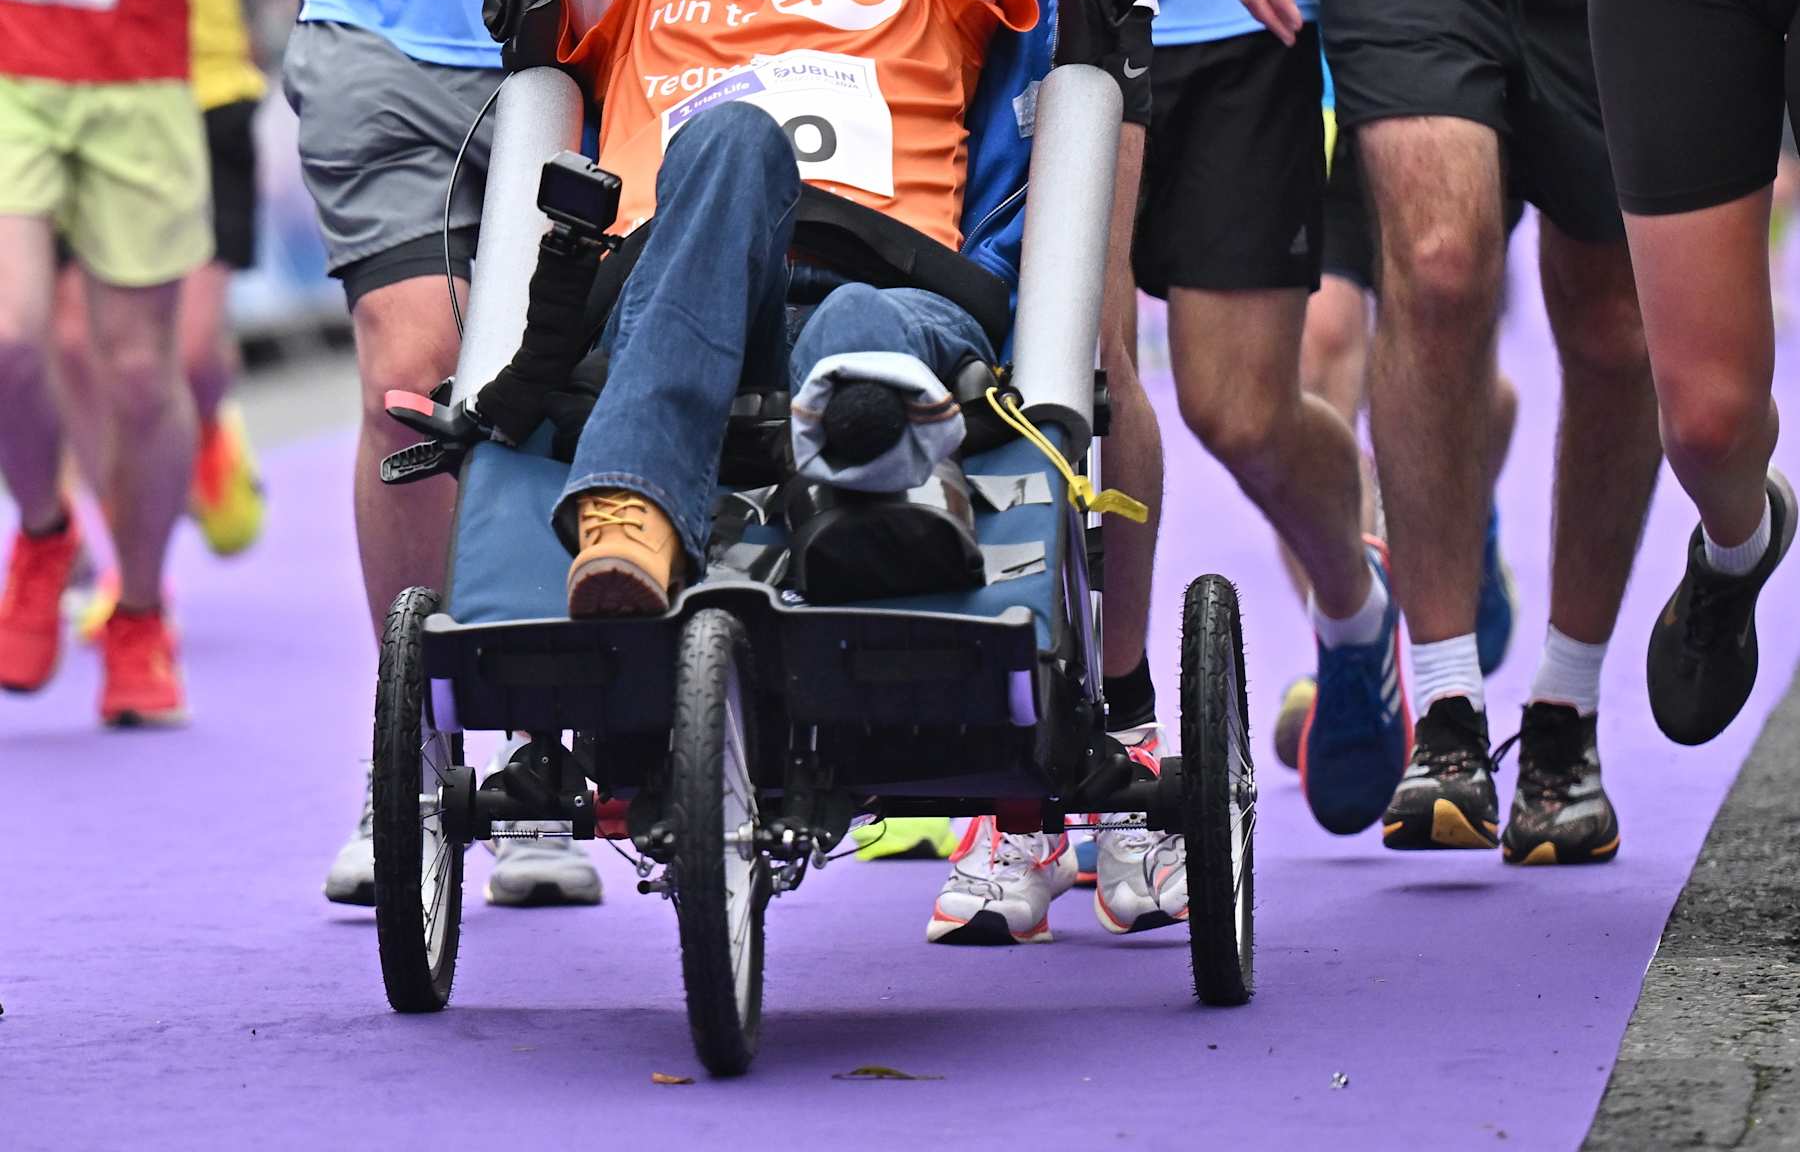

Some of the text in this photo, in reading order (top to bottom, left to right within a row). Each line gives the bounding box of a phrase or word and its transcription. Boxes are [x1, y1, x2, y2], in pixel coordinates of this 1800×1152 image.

[649, 0, 712, 32] run
[773, 64, 856, 83] DUBLIN
[723, 81, 751, 95] Life
